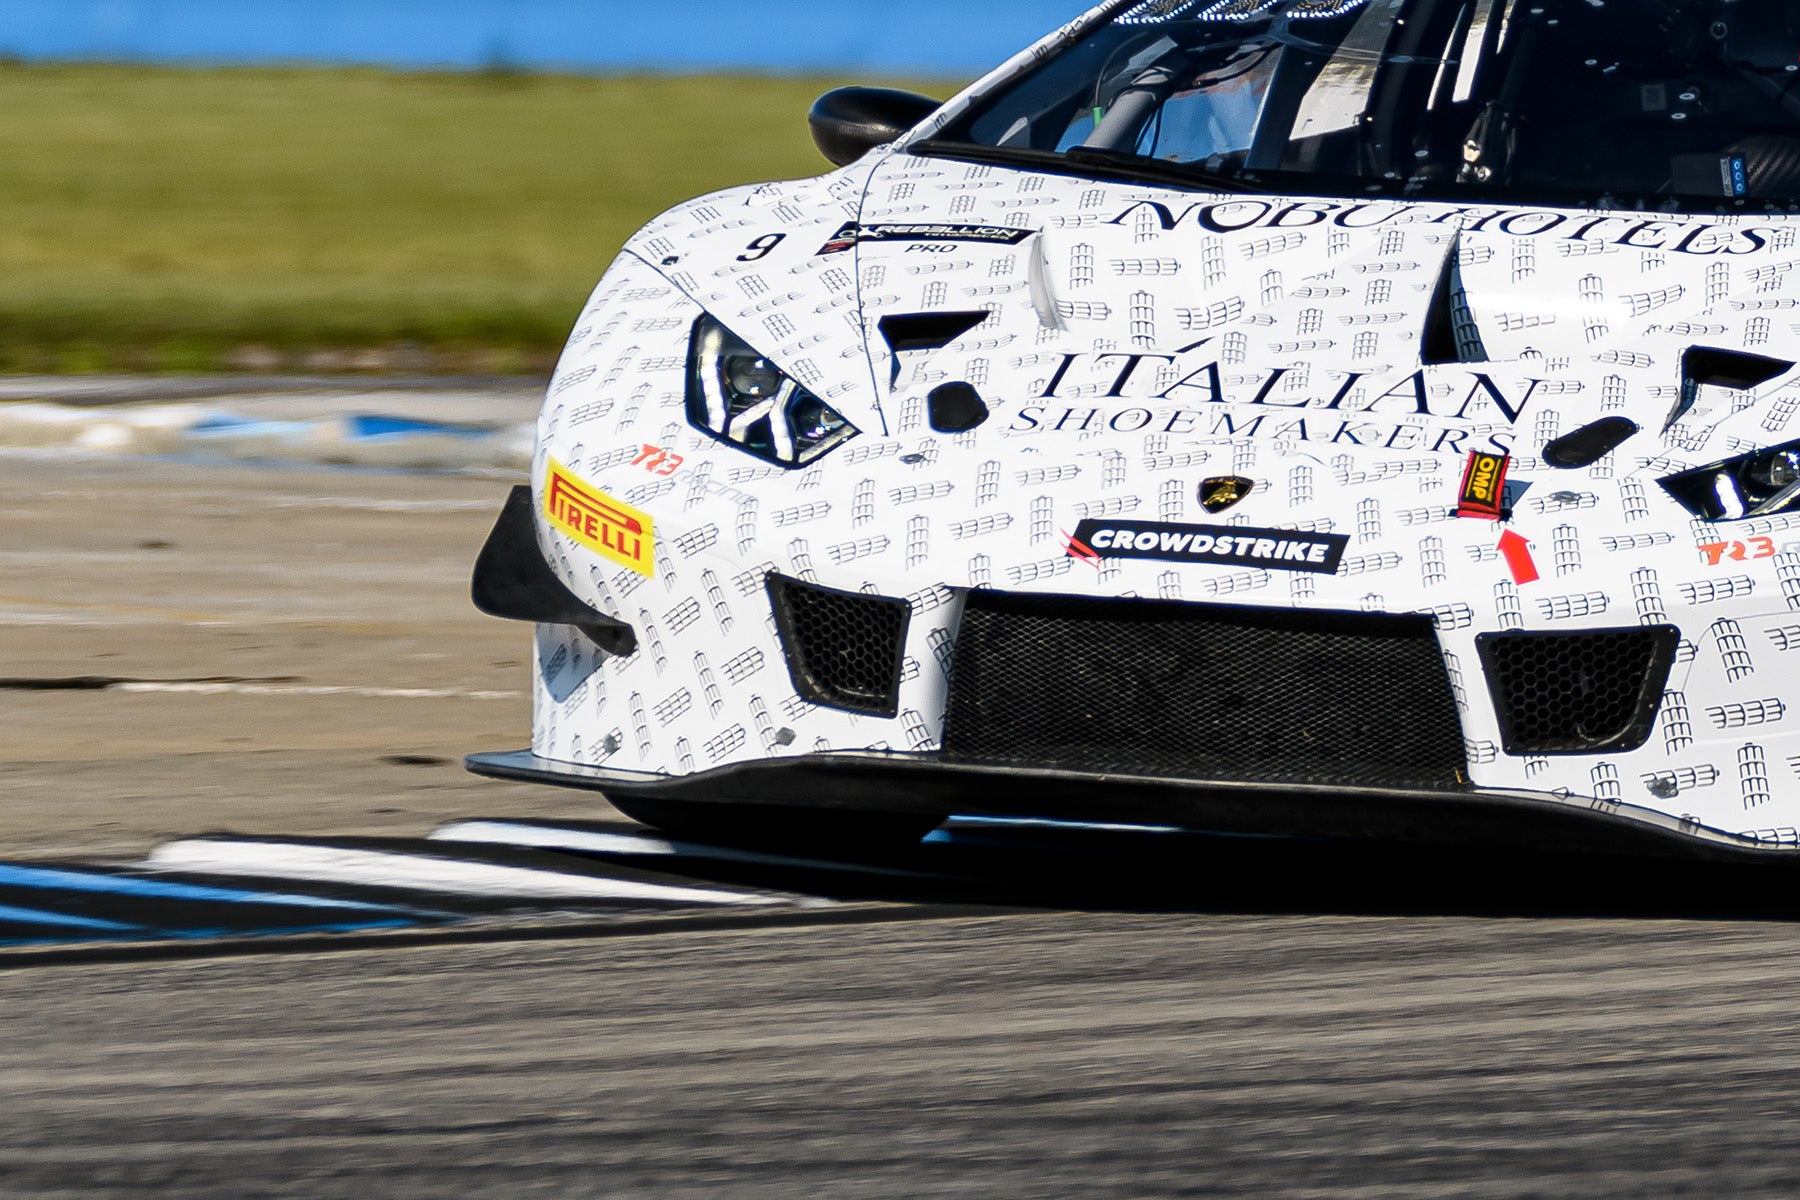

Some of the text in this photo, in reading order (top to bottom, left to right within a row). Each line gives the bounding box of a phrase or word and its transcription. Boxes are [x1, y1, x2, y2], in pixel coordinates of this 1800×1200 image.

[737, 233, 786, 261] 9
[905, 244, 958, 253] PRO
[1105, 200, 1784, 254] NOBU HOTELS
[1038, 351, 1542, 424] ITALIAN
[1008, 406, 1516, 456] SHOEMAKERS
[1472, 457, 1495, 499] OMP
[549, 471, 642, 561] PIRELLI
[1091, 529, 1330, 563] CROWDSTRIKE
